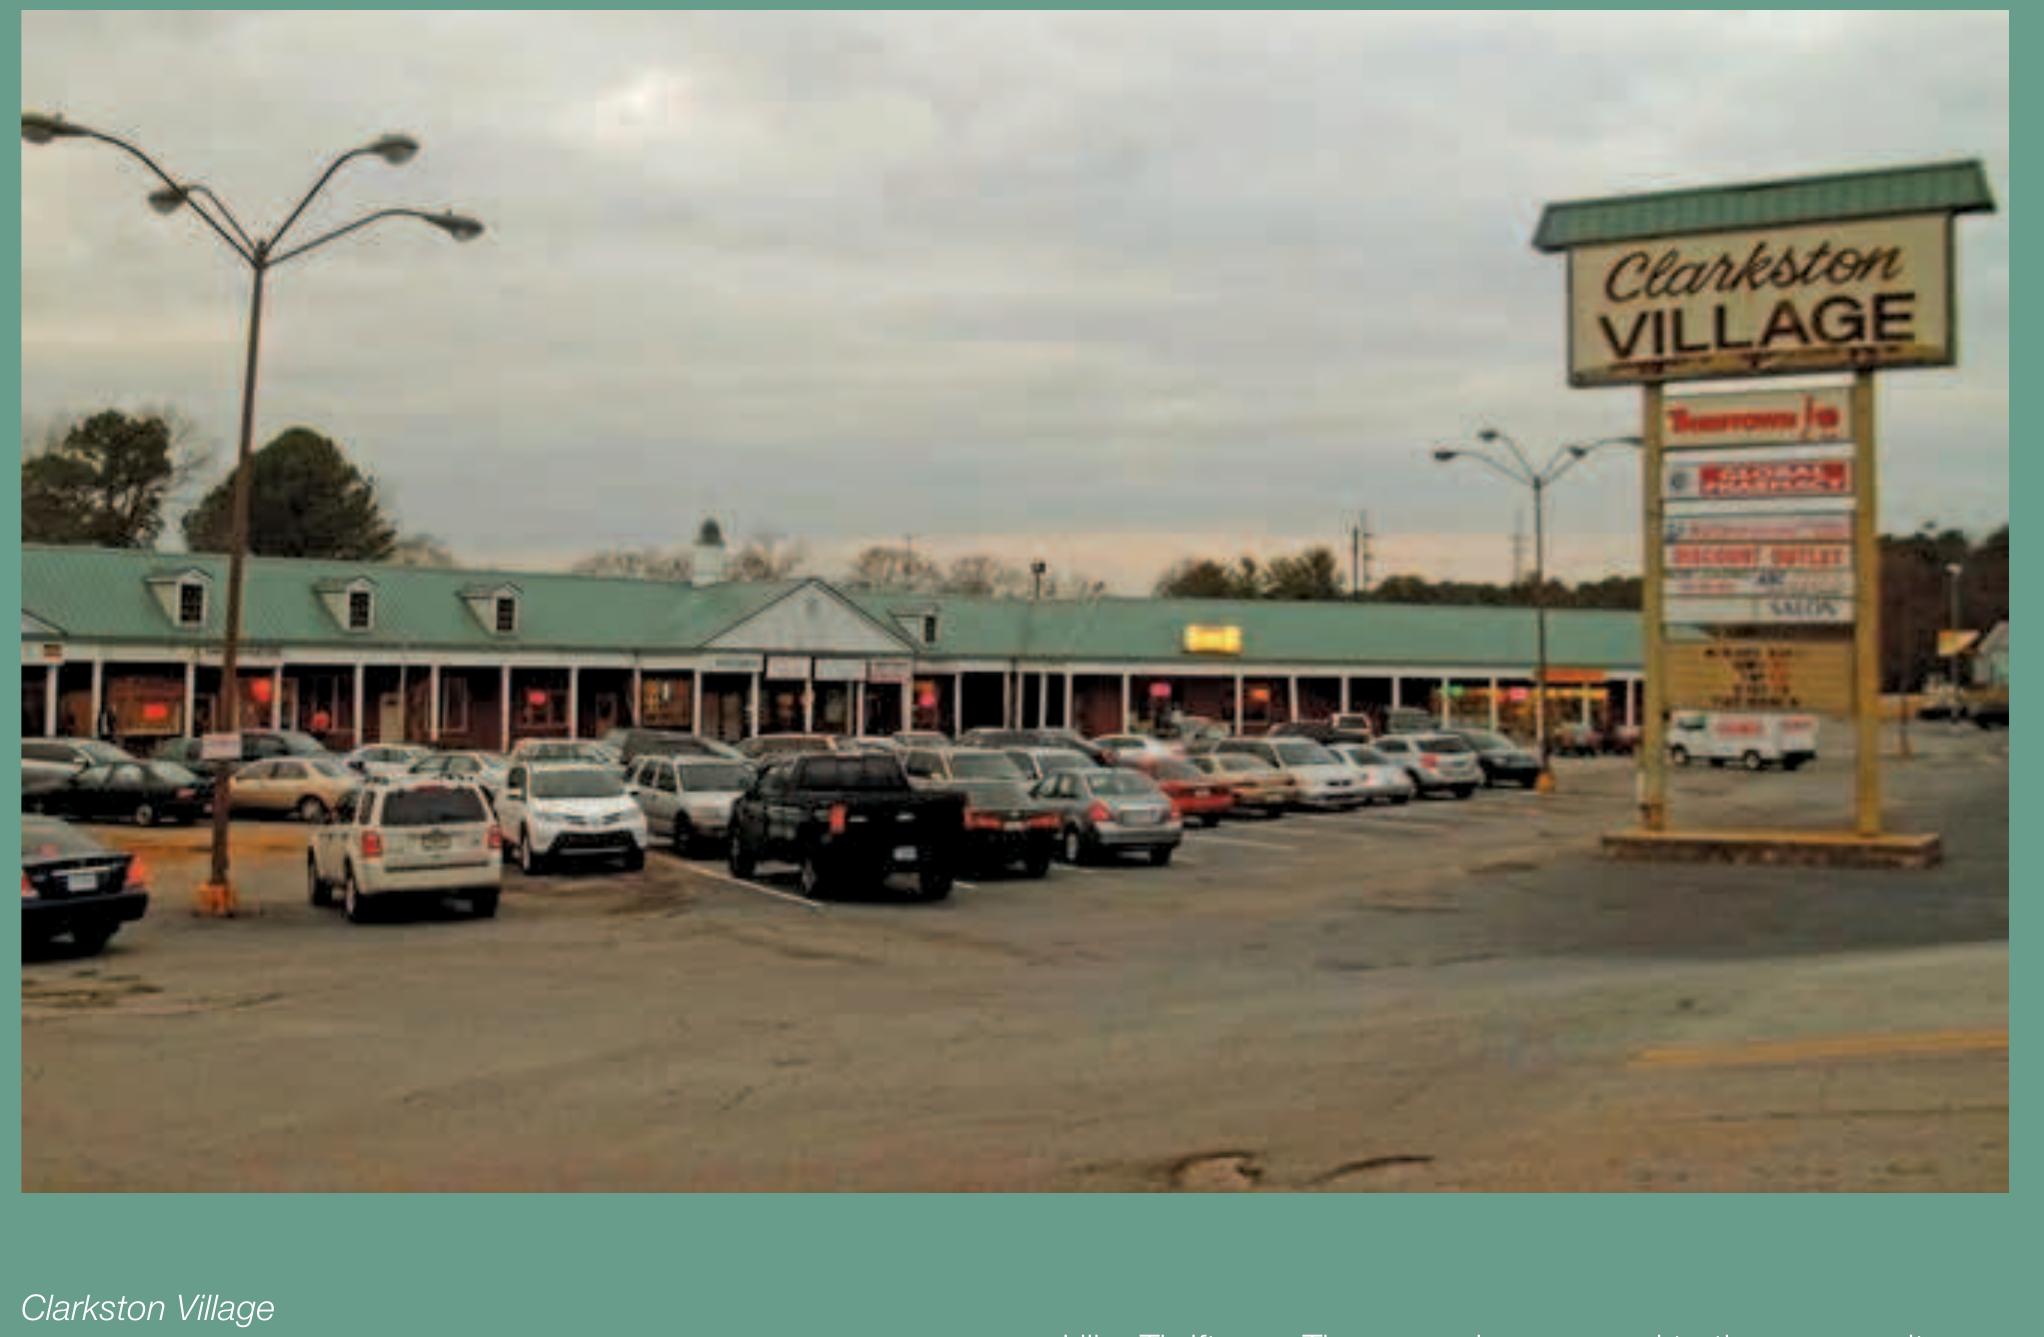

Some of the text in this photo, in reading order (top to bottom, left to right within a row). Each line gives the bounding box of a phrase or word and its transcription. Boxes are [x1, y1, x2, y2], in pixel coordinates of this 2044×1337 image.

[1605, 240, 1904, 301] Clarkston
[1599, 292, 1917, 359] VILLAGE
[1674, 544, 1845, 567] DISCOUNT OUTLET
